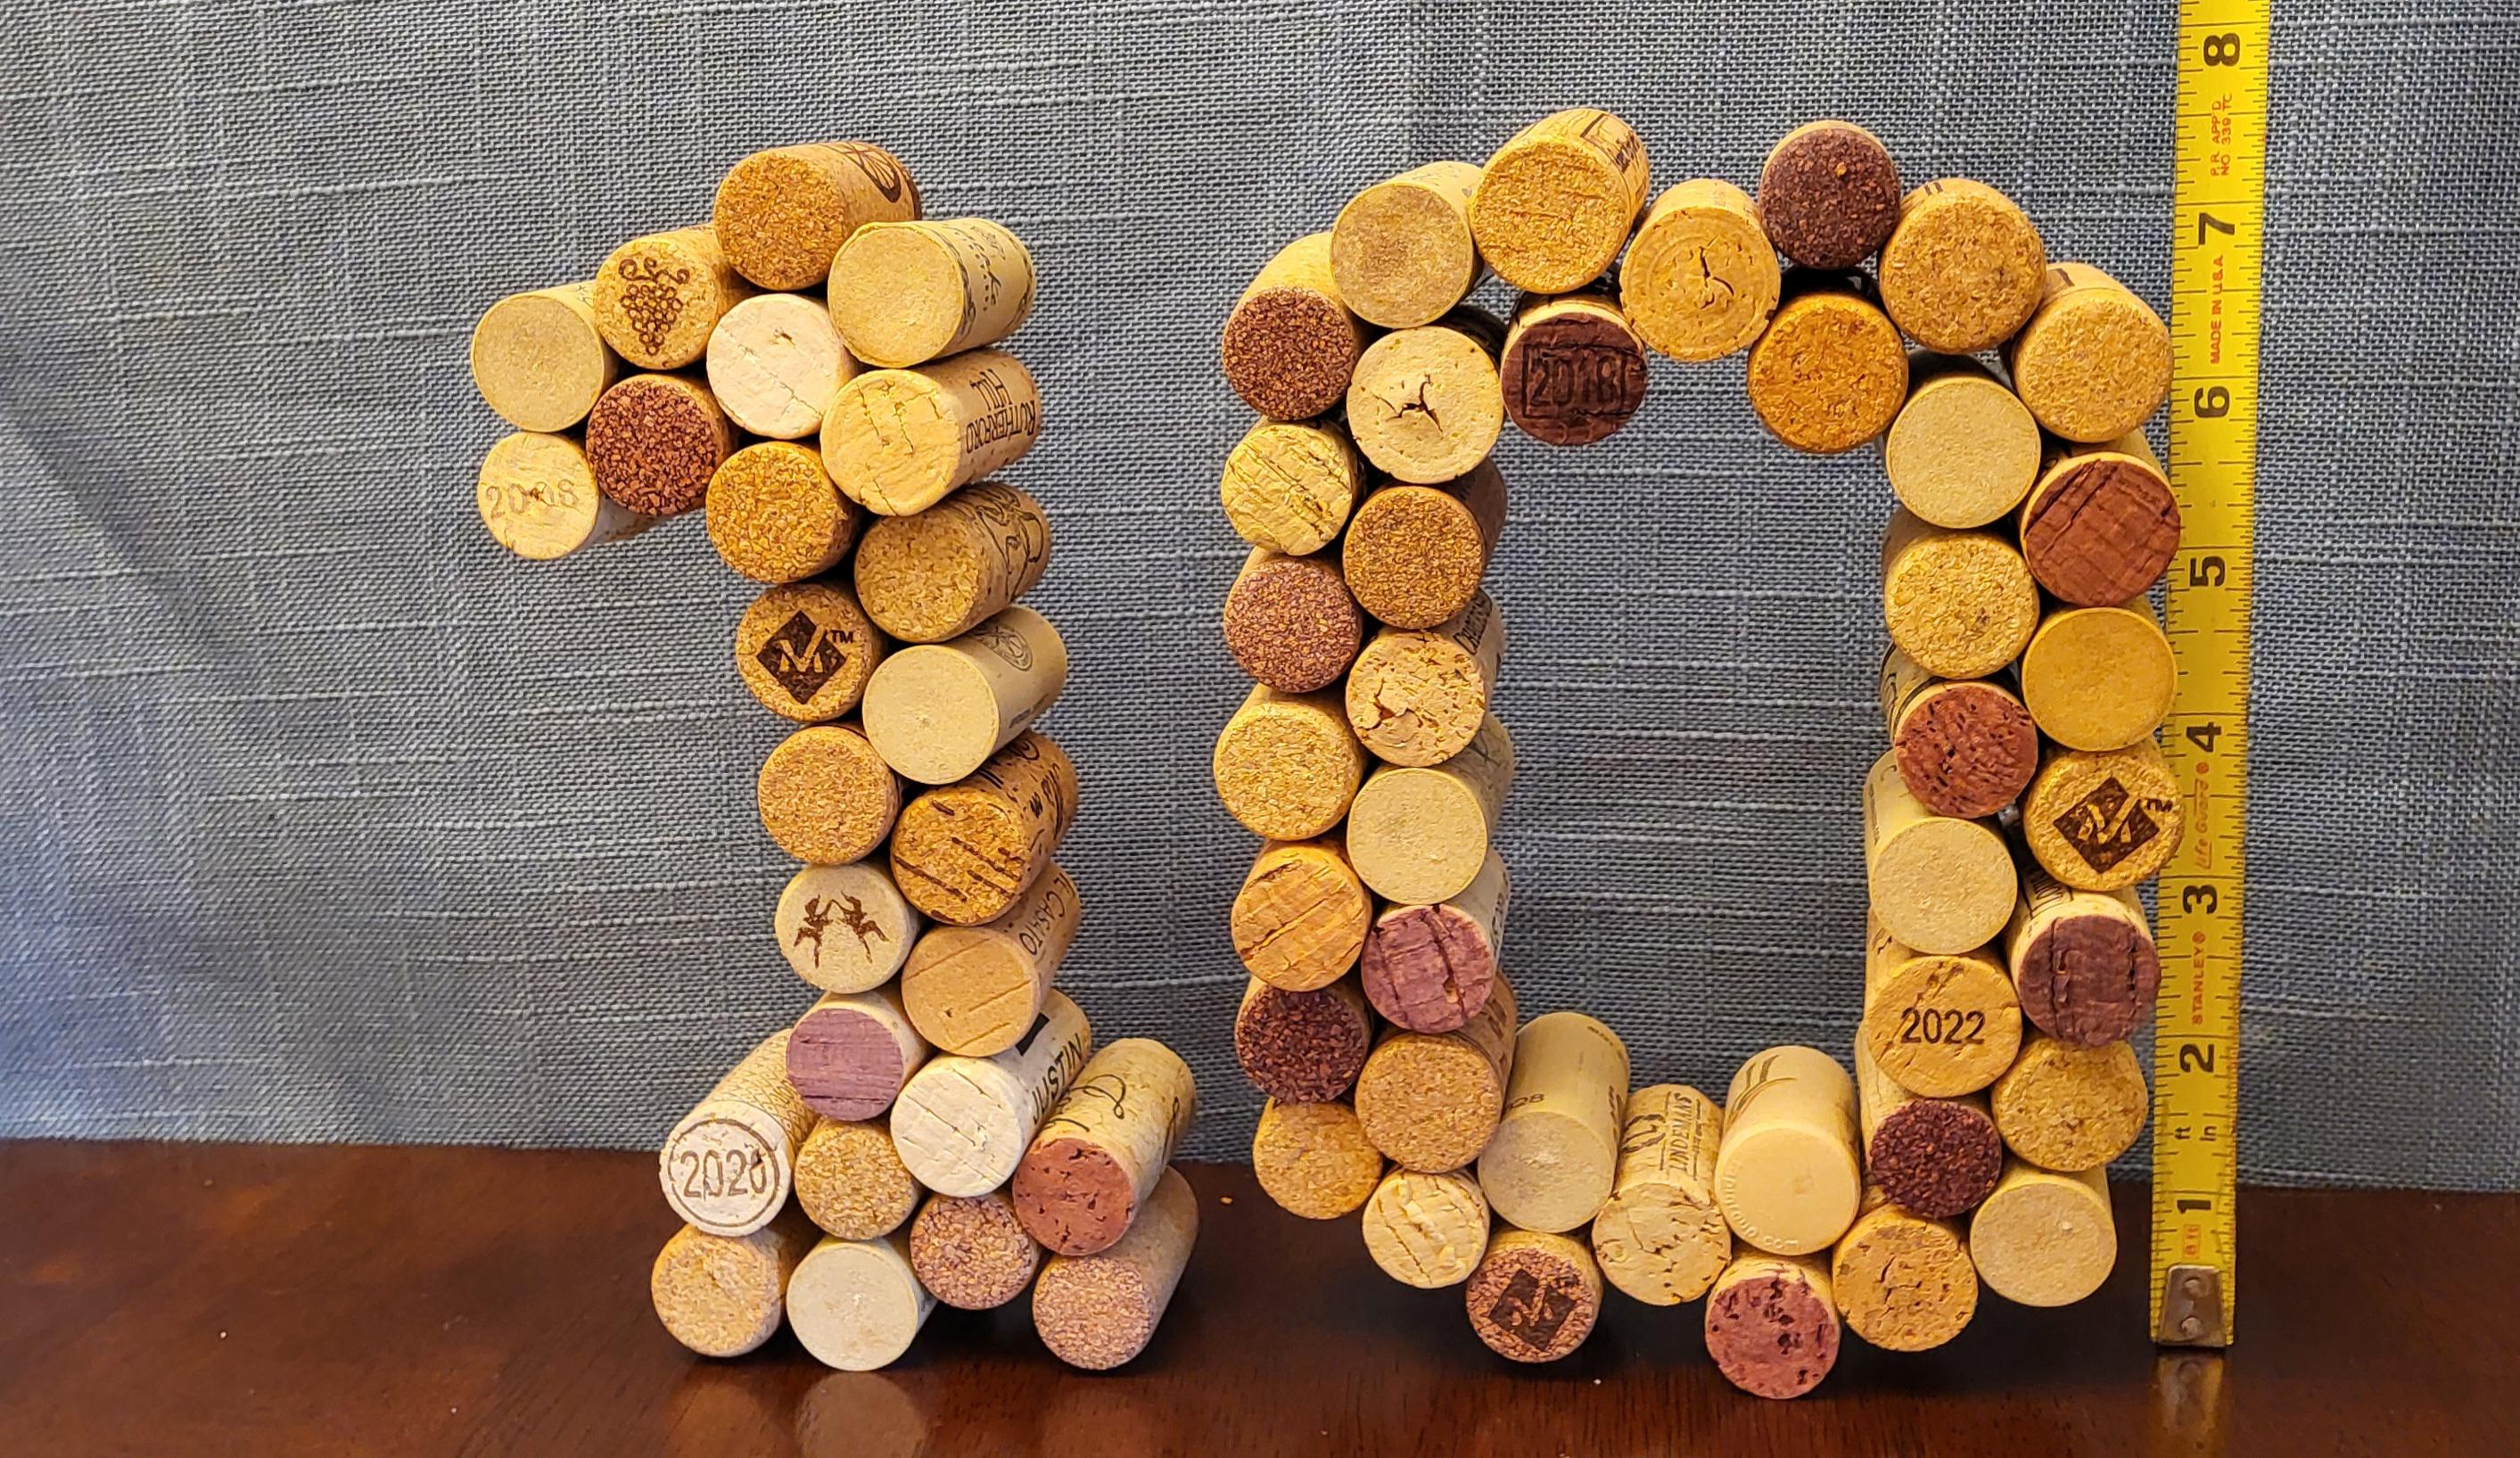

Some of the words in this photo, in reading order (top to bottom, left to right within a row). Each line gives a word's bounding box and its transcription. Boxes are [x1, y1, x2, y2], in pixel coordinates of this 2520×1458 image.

[2203, 33, 2240, 66] 8
[2198, 212, 2235, 245] 7
[2211, 300, 2221, 315] IN
[2211, 320, 2221, 364] MADE
[969, 368, 1013, 411] HILL
[2195, 386, 2229, 418] 6
[966, 400, 1036, 454] RUTHERFORD
[2189, 556, 2226, 587] 5
[2186, 721, 2221, 753] 4
[2183, 885, 2218, 914] 3
[2192, 946, 2204, 1026] STANLEY
[1900, 1007, 1986, 1044] 2022
[2179, 1043, 2215, 1073] 2
[1032, 1034, 1083, 1125] JUSTIN
[1668, 1092, 1692, 1172] LINDEMANS
[2175, 1126, 2191, 1140] ft
[680, 1149, 768, 1198] 2020
[2177, 1199, 2211, 1214] 1
